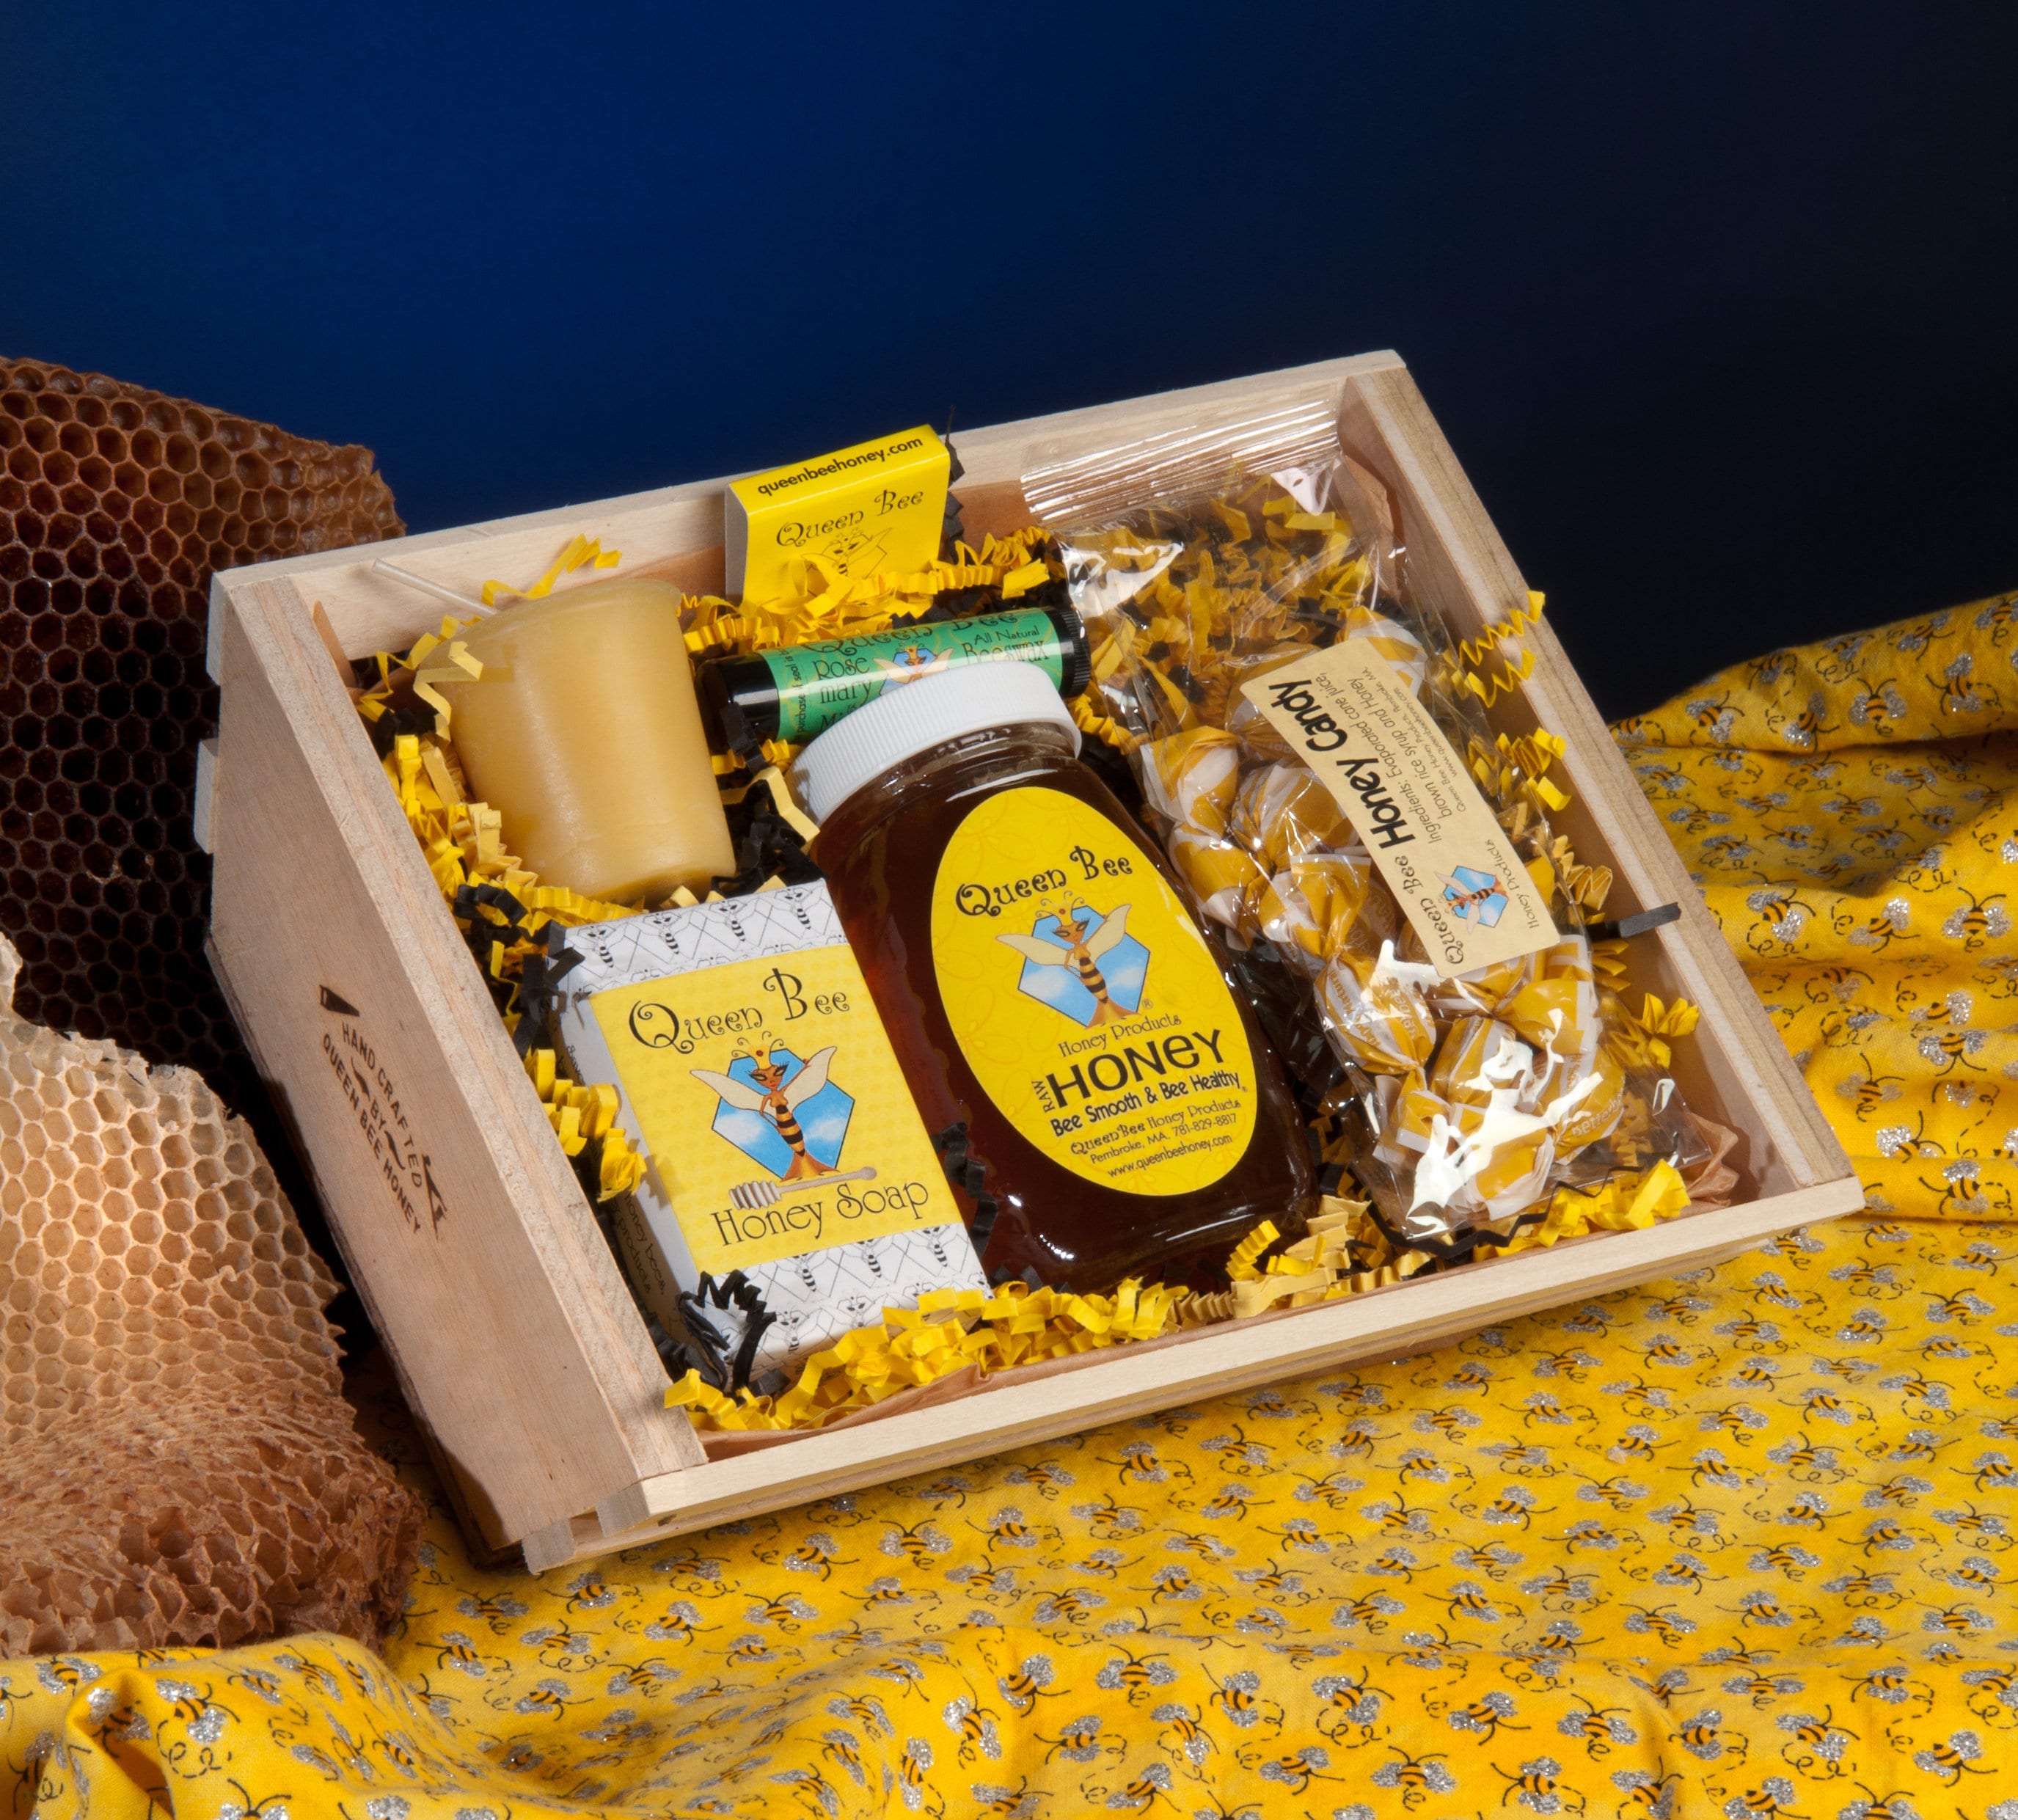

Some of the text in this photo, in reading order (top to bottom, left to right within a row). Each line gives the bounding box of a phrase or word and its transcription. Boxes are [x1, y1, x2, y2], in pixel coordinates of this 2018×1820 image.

[758, 439, 922, 496] queenbeehoney.com
[777, 490, 924, 546] Queen Bee
[973, 625, 1040, 646] All Natural
[785, 663, 802, 682] seal
[813, 657, 870, 681] Rose
[819, 679, 872, 707] mary
[1269, 680, 1347, 751] Candy
[1316, 673, 1441, 843] Ingredients: Evaporated cane juice,
[1348, 679, 1452, 819] brown rice syrup and Honey
[1425, 745, 1440, 768] Honey
[1337, 759, 1415, 848] Honey
[1439, 770, 1450, 785] Bee
[1449, 786, 1466, 811] Queen
[956, 847, 1132, 916] Queen Bee
[1395, 856, 1423, 894] Bee
[1485, 840, 1539, 928] Honey Products
[1420, 898, 1463, 964] Queen
[629, 968, 850, 1054] Queen Bee
[1059, 1014, 1181, 1057] Honey Products
[1031, 1081, 1055, 1112] RAW
[1046, 1029, 1223, 1108] HONEY
[343, 1023, 423, 1187] HAND CRAFTED
[370, 1100, 386, 1133] BY
[1051, 1072, 1240, 1136] Bee Smooth & Bee Healthy
[1147, 1112, 1183, 1128] Honey
[1188, 1100, 1240, 1122] Products
[323, 1034, 420, 1232] QUEEN BEE HONEY
[1091, 1114, 1235, 1163] Pembroke, MA. 781-829-8817
[1108, 1136, 1232, 1177] www.queenbeehoney.com
[711, 1183, 928, 1245] Honey Soap
